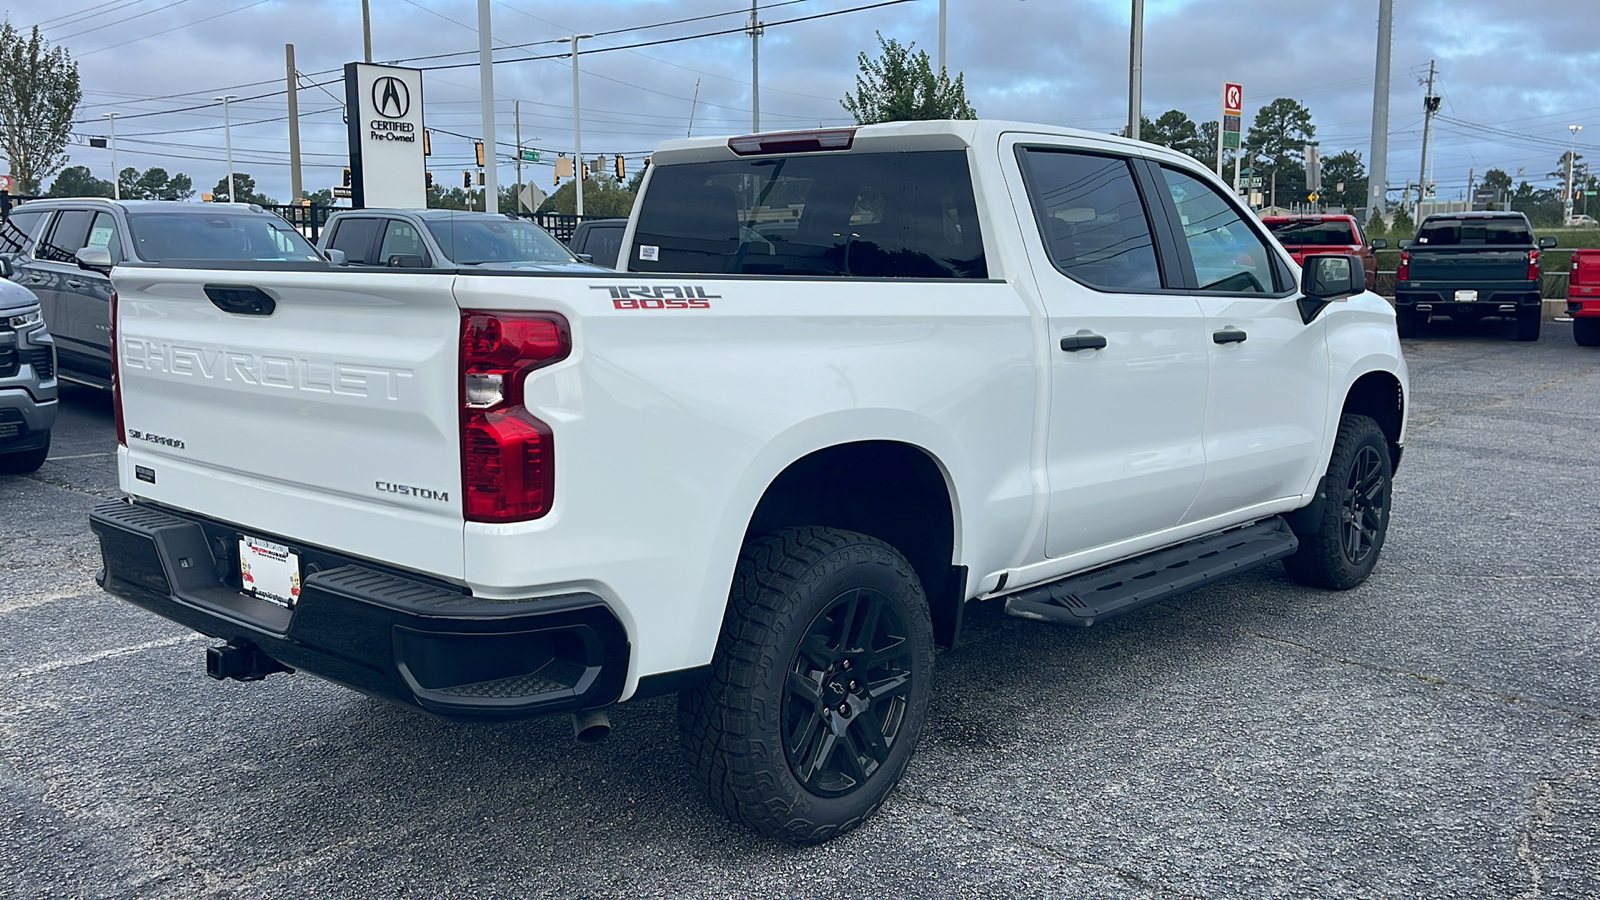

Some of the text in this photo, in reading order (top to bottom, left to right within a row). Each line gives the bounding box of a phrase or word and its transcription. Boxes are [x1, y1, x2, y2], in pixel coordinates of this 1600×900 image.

[370, 120, 415, 132] CERTIFIED
[371, 131, 415, 142] Pre-Owned
[588, 285, 723, 299] TRAIL
[612, 299, 711, 309] BOSS
[124, 339, 414, 400] CHEVROLET
[128, 429, 185, 449] SILVERADO
[375, 481, 449, 502] CUSTOM
